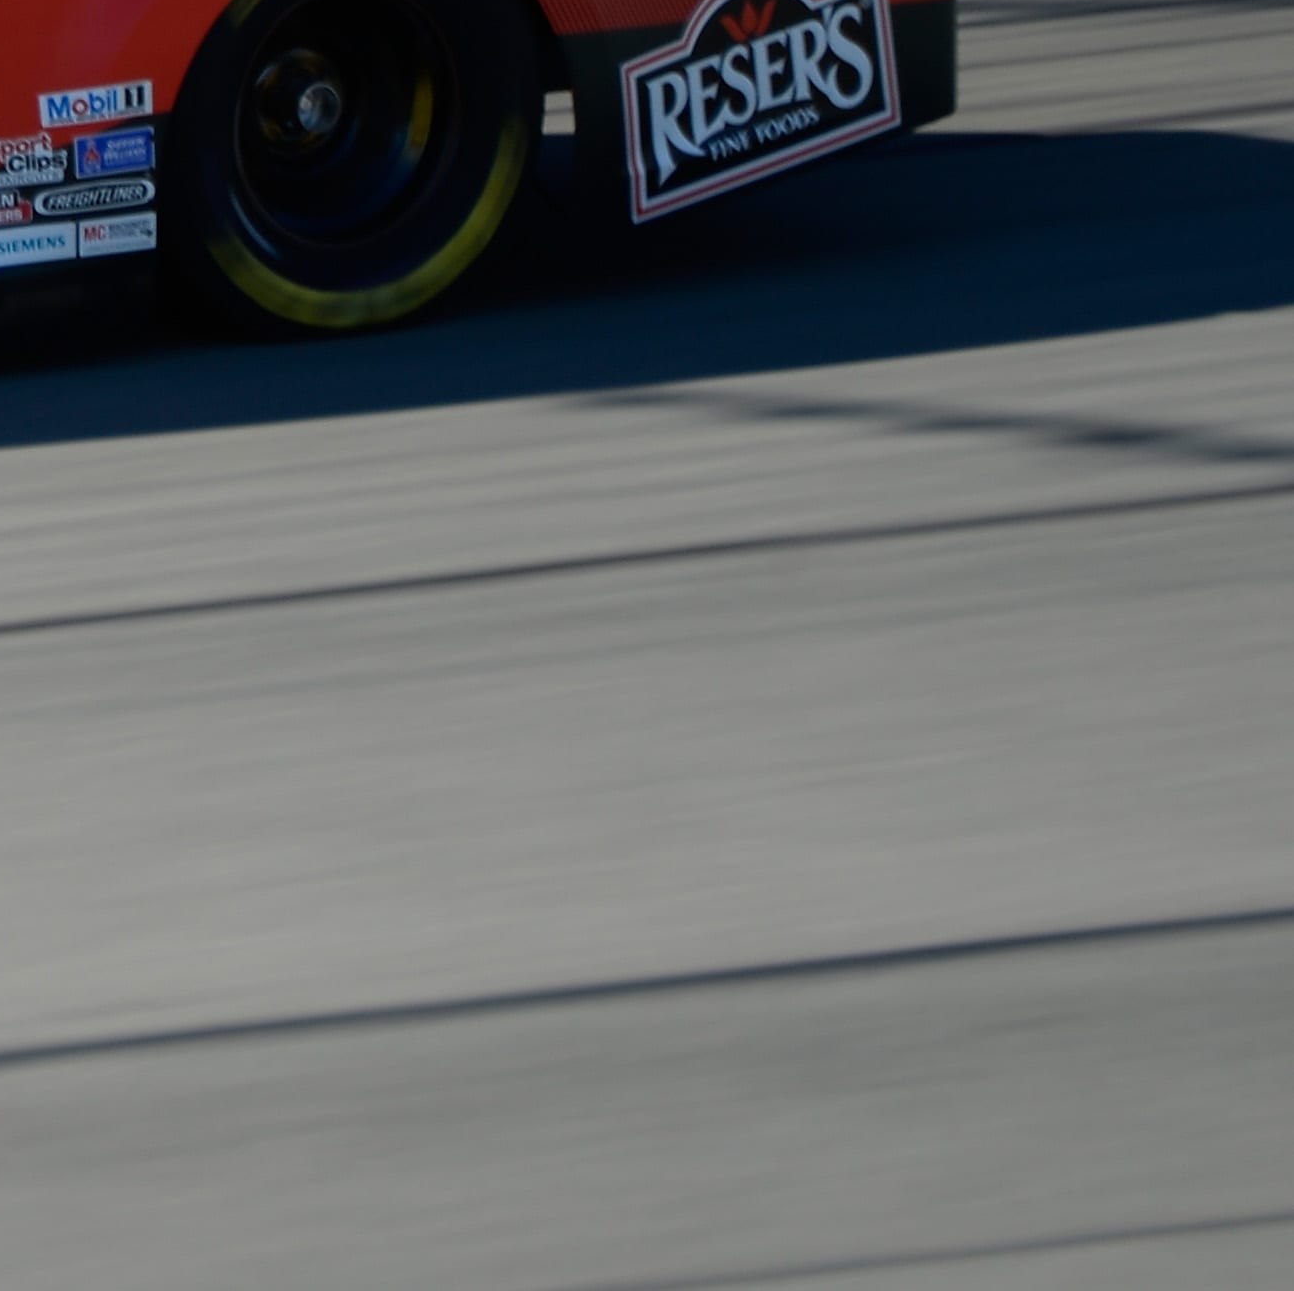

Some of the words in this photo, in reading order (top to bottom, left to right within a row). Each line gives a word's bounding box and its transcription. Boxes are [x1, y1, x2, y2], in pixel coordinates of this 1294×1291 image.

[47, 90, 118, 120] Mobil
[644, 3, 873, 186] RESER'S
[709, 131, 753, 163] FINE
[756, 106, 820, 146] FOODS
[8, 152, 67, 176] Clips
[46, 183, 145, 210] FREIGHTLINER
[83, 225, 108, 243] MC
